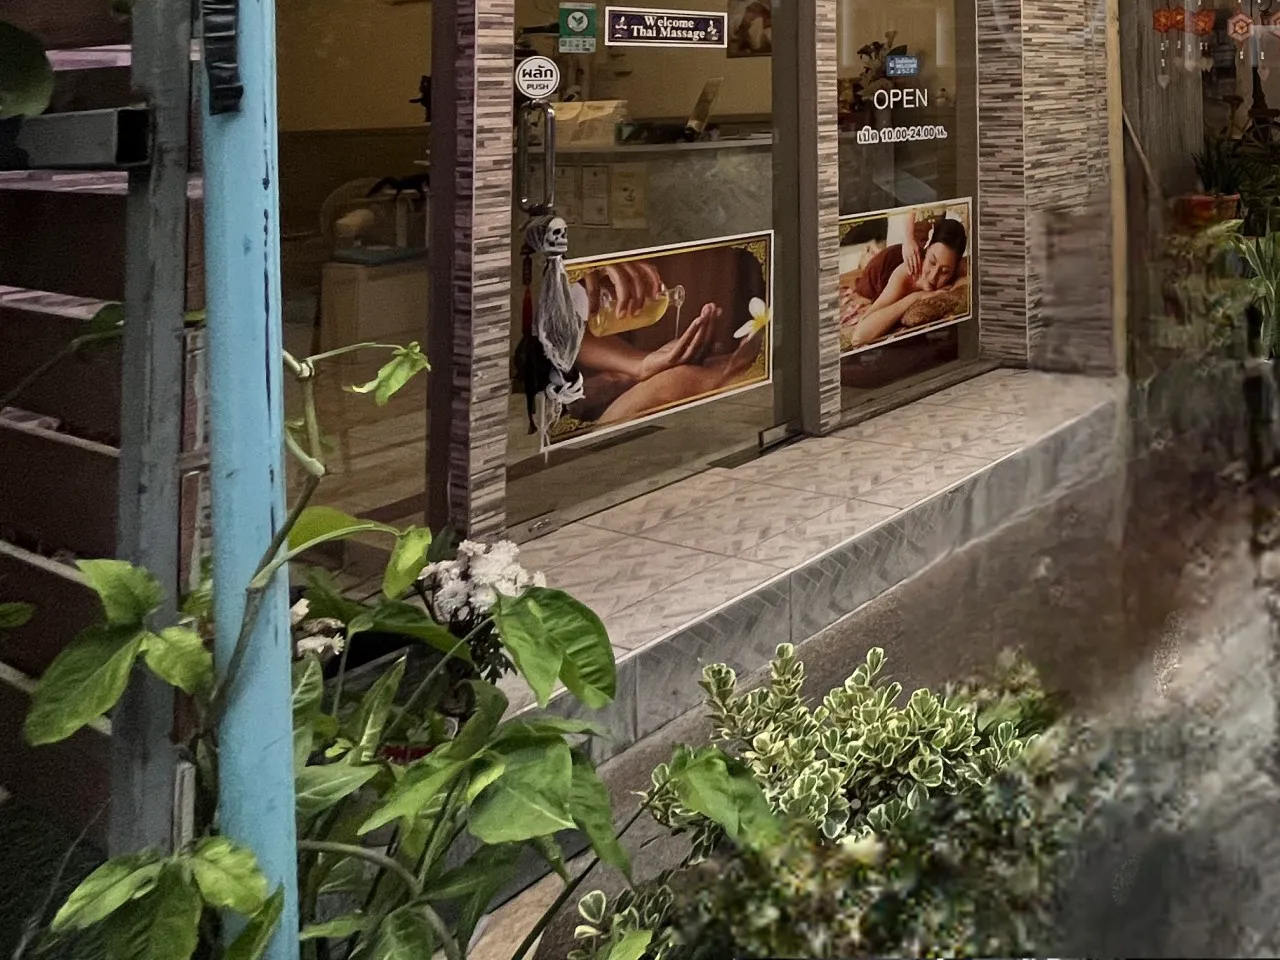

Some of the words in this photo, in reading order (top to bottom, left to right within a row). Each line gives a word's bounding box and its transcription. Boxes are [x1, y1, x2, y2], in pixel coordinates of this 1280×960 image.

[644, 16, 695, 28] Welcome
[630, 25, 656, 38] Thai
[659, 27, 706, 41] Massage
[522, 65, 553, 78] ผลัก
[873, 88, 928, 110] OPEN
